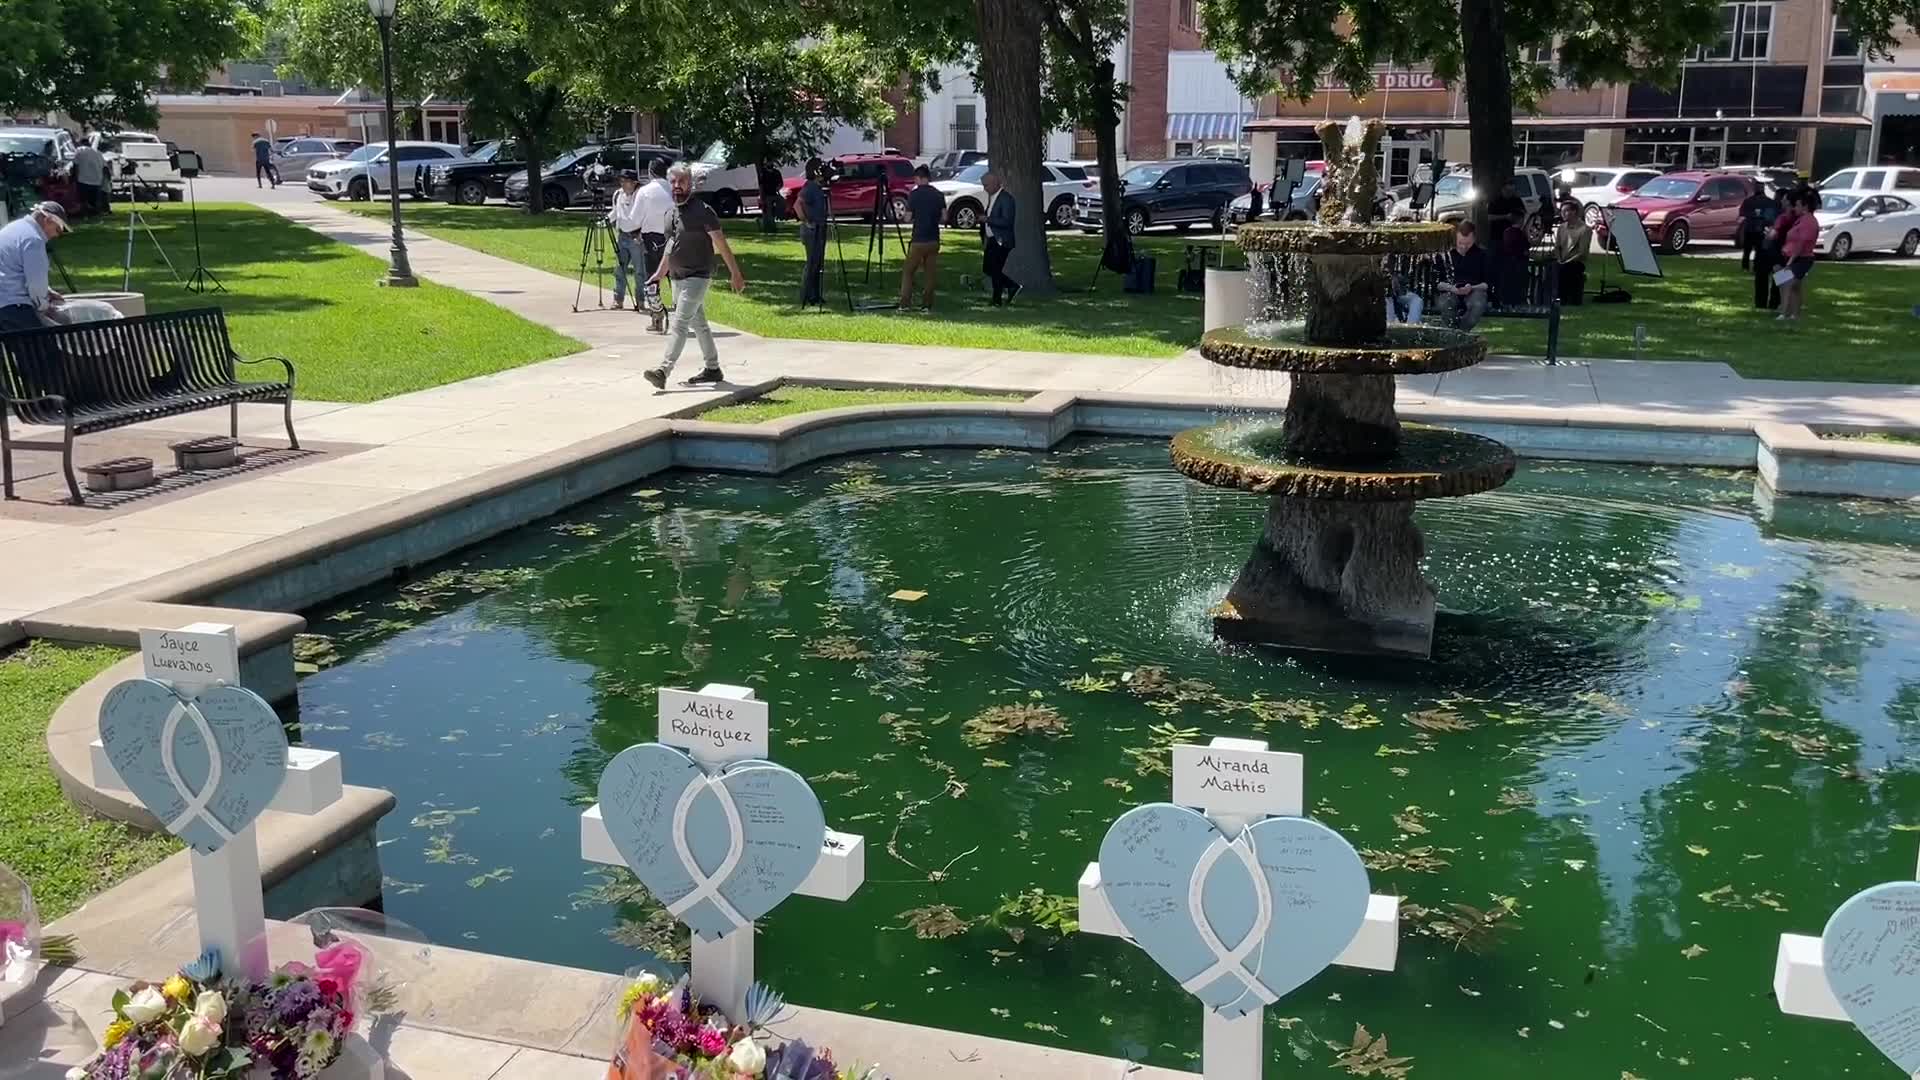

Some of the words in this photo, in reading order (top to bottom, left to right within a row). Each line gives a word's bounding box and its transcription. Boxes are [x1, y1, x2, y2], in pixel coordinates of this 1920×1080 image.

[1385, 73, 1435, 88] DRUG
[158, 632, 200, 655] Jayce
[151, 654, 214, 674] Luevanos
[682, 701, 735, 721] Maite
[671, 718, 753, 748] Rodriguez
[1196, 755, 1270, 775] Miranda
[1200, 775, 1267, 794] Mathis
